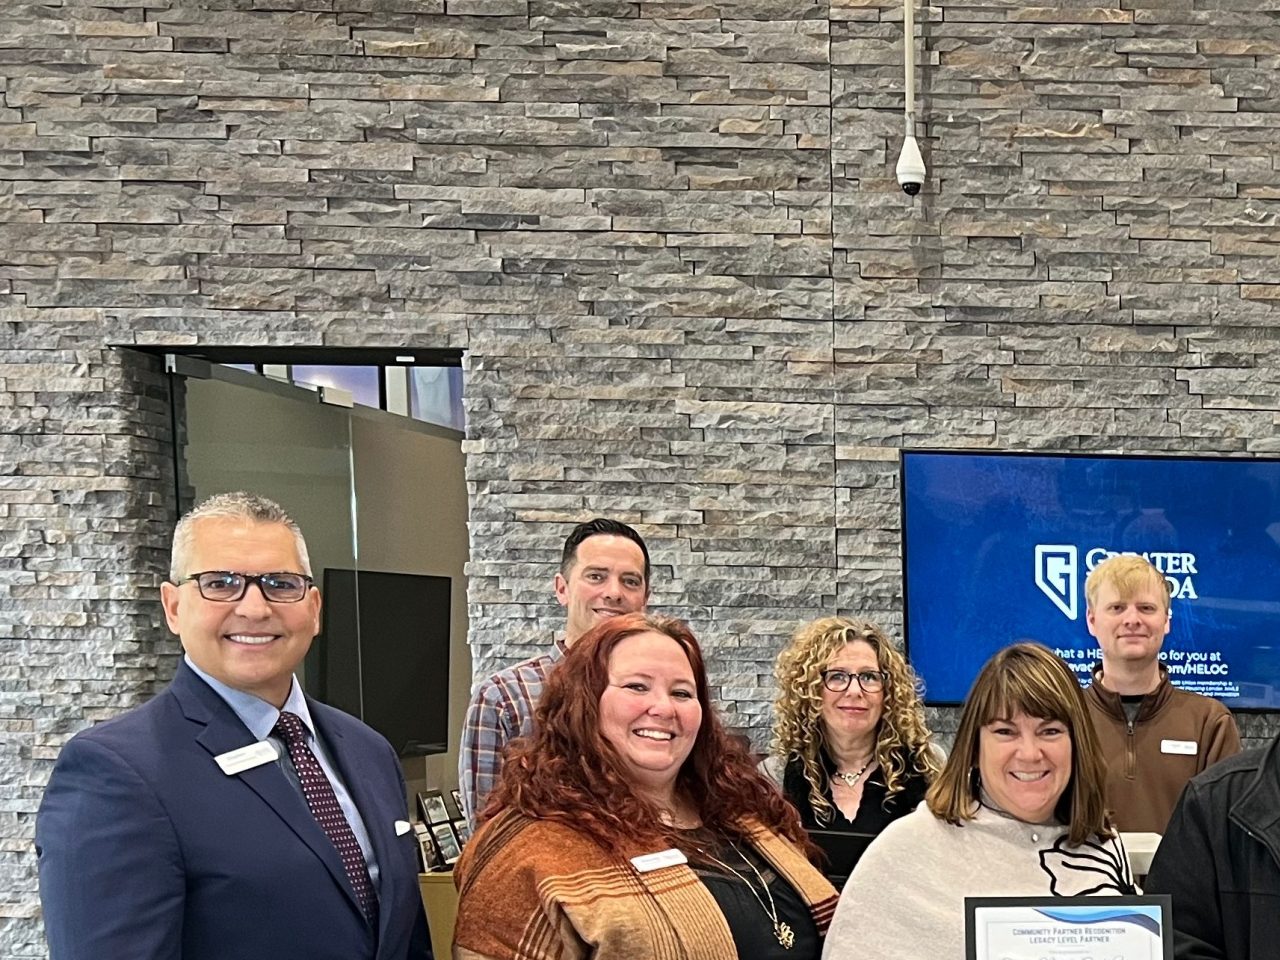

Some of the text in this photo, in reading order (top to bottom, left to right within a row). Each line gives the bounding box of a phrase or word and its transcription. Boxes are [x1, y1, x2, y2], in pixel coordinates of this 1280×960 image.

[1077, 649, 1085, 659] a
[1169, 649, 1185, 661] for
[1186, 652, 1208, 663] you
[1209, 651, 1221, 662] at
[1052, 927, 1083, 935] PARTNER
